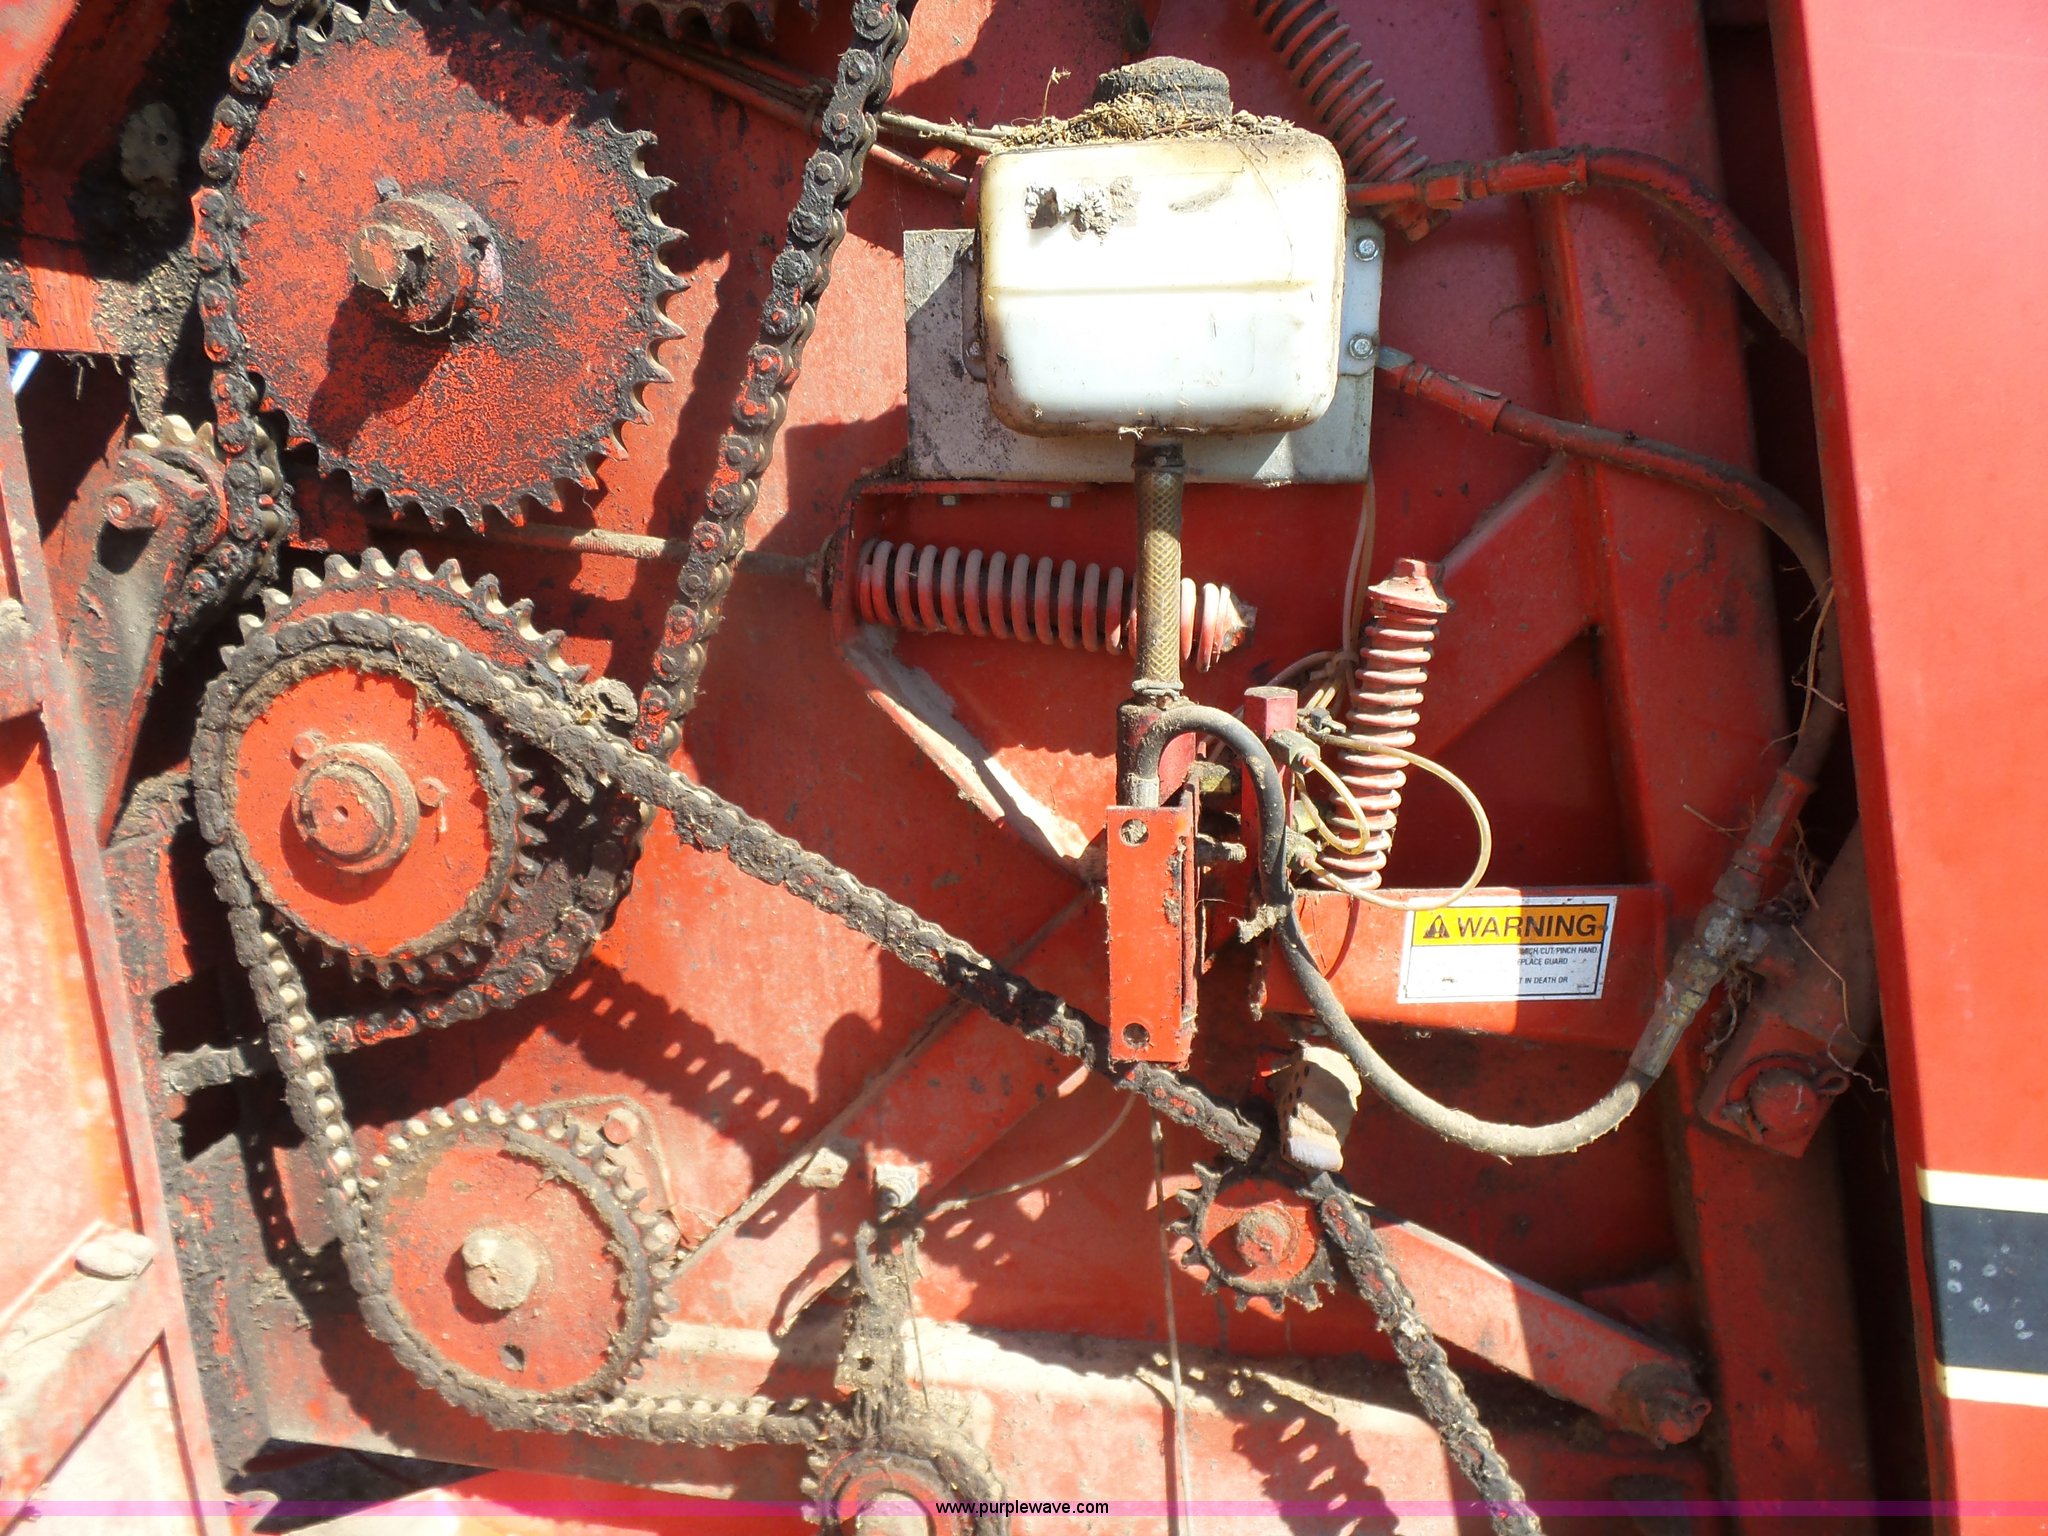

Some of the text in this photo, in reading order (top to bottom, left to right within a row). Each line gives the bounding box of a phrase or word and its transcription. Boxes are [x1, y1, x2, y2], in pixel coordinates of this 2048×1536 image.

[1457, 914, 1597, 937] WARNING
[1544, 957, 1569, 965] GUARD
[1533, 976, 1557, 984] DEATH
